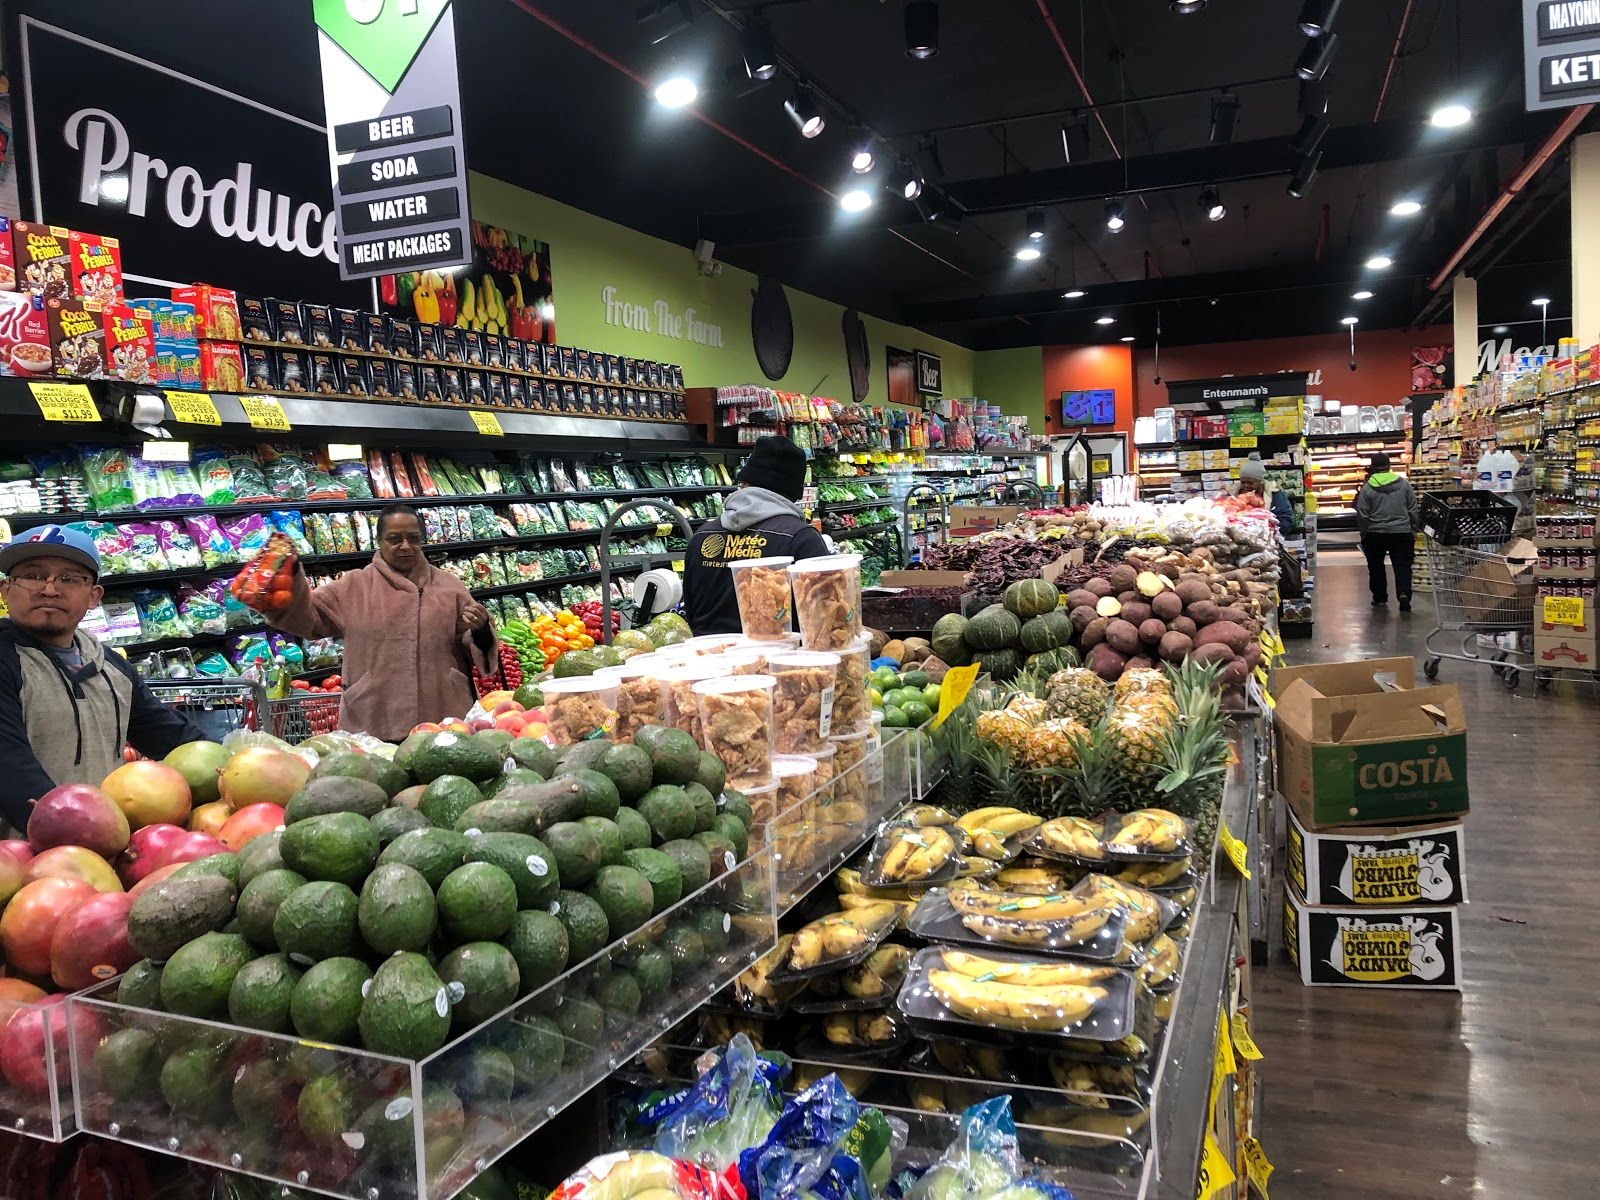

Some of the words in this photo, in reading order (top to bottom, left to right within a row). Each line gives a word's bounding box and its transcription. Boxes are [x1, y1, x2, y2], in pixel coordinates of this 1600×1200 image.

[368, 116, 415, 142] BEER
[371, 156, 418, 182] SODA
[369, 195, 428, 222] WATER
[27, 232, 58, 247] COCOA
[26, 245, 63, 261] PEBBLES
[80, 243, 109, 255] FRUITY
[352, 242, 385, 265] MEAT
[388, 232, 451, 257] PACKAGES
[79, 253, 114, 270] PEBBLES
[60, 309, 92, 322] COCOA
[113, 316, 142, 328] FRUITY
[602, 285, 651, 333] From
[653, 299, 682, 339] The
[685, 307, 724, 348] Farm
[24, 326, 46, 335] Berries
[60, 320, 97, 337] PEBBLES
[112, 326, 148, 343] PEBBLES
[212, 345, 239, 355] winter's
[922, 359, 939, 387] Beer
[37, 396, 89, 404] KELLOGG'S
[1203, 386, 1269, 399] Entenmann's
[62, 409, 93, 419] $11.99
[174, 406, 215, 414] COOKIES
[191, 413, 216, 423] $2.99
[264, 418, 285, 426] $7.99
[723, 546, 762, 559] Média
[1359, 756, 1454, 790] COSTA
[1357, 859, 1379, 867] YAMS
[1354, 864, 1419, 883] JUMBO
[1355, 881, 1420, 898] DANDY
[1347, 932, 1369, 941] YAMS
[1345, 940, 1410, 956] JUMBO
[1345, 957, 1410, 972] DANDY
